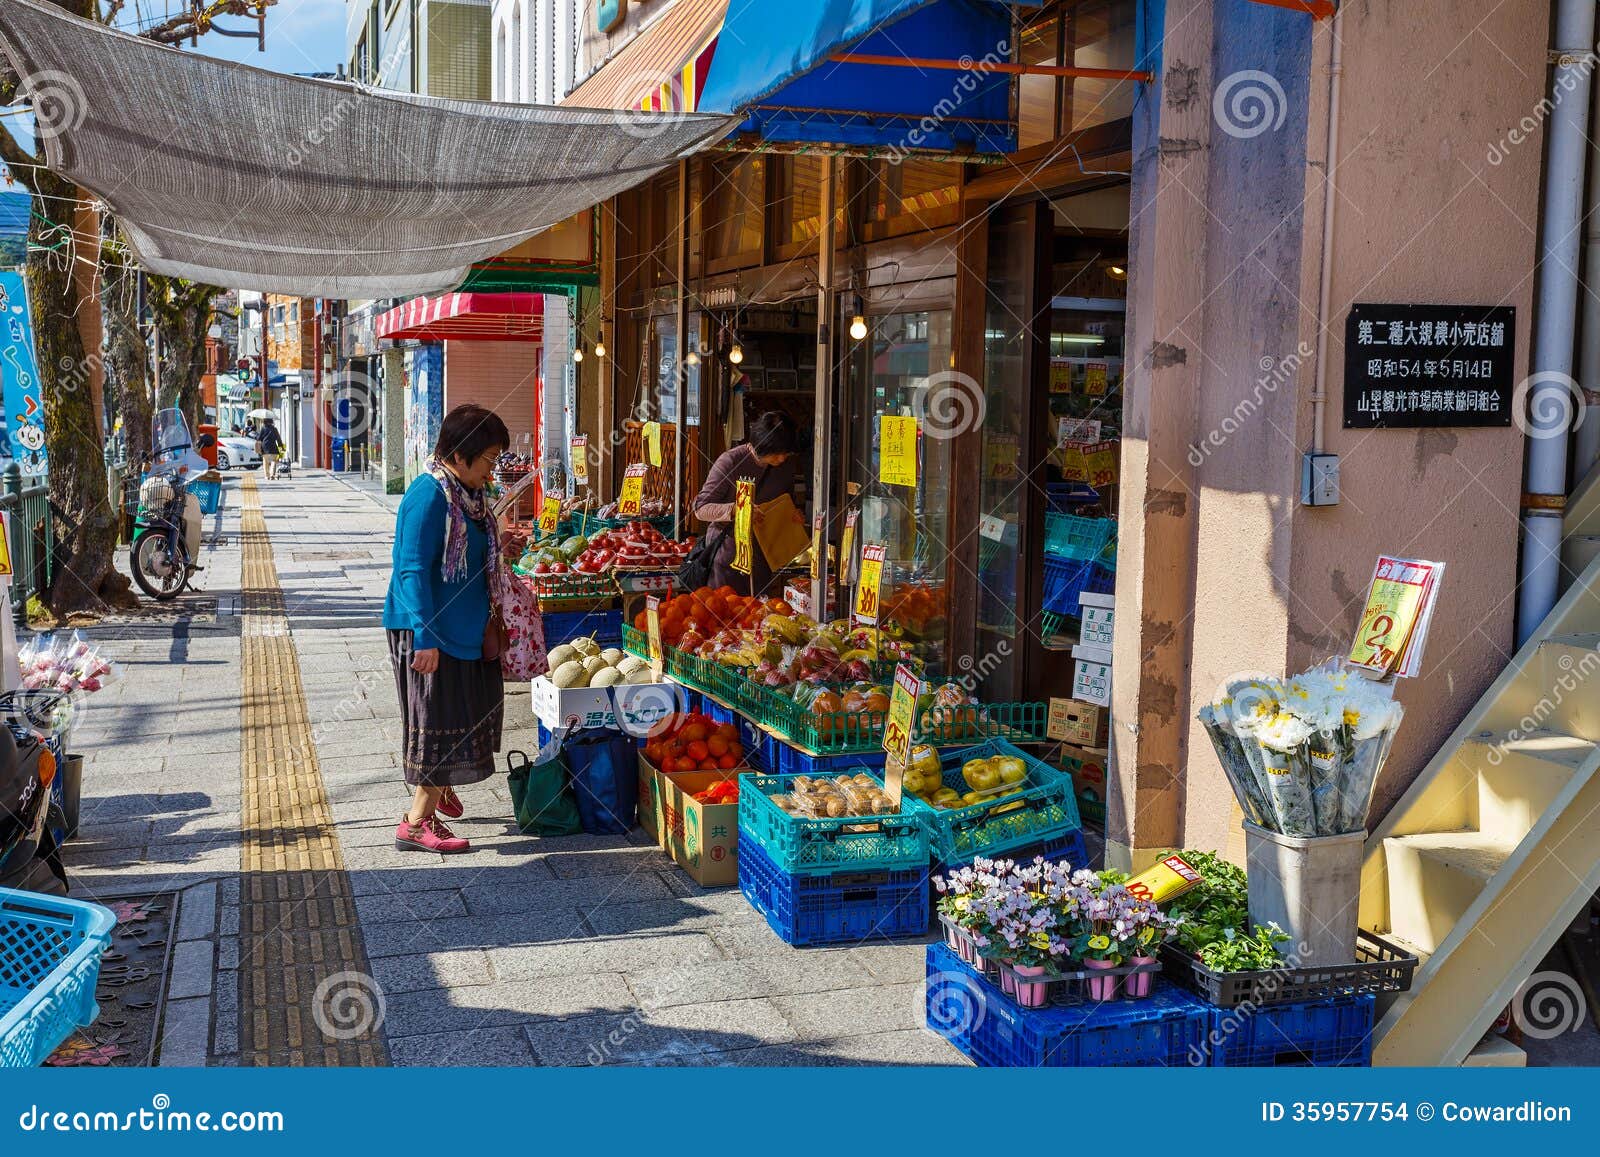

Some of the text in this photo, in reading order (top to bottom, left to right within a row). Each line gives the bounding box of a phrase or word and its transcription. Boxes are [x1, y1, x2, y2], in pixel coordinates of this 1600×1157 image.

[1367, 358, 1492, 378] 昭和54年5月14日
